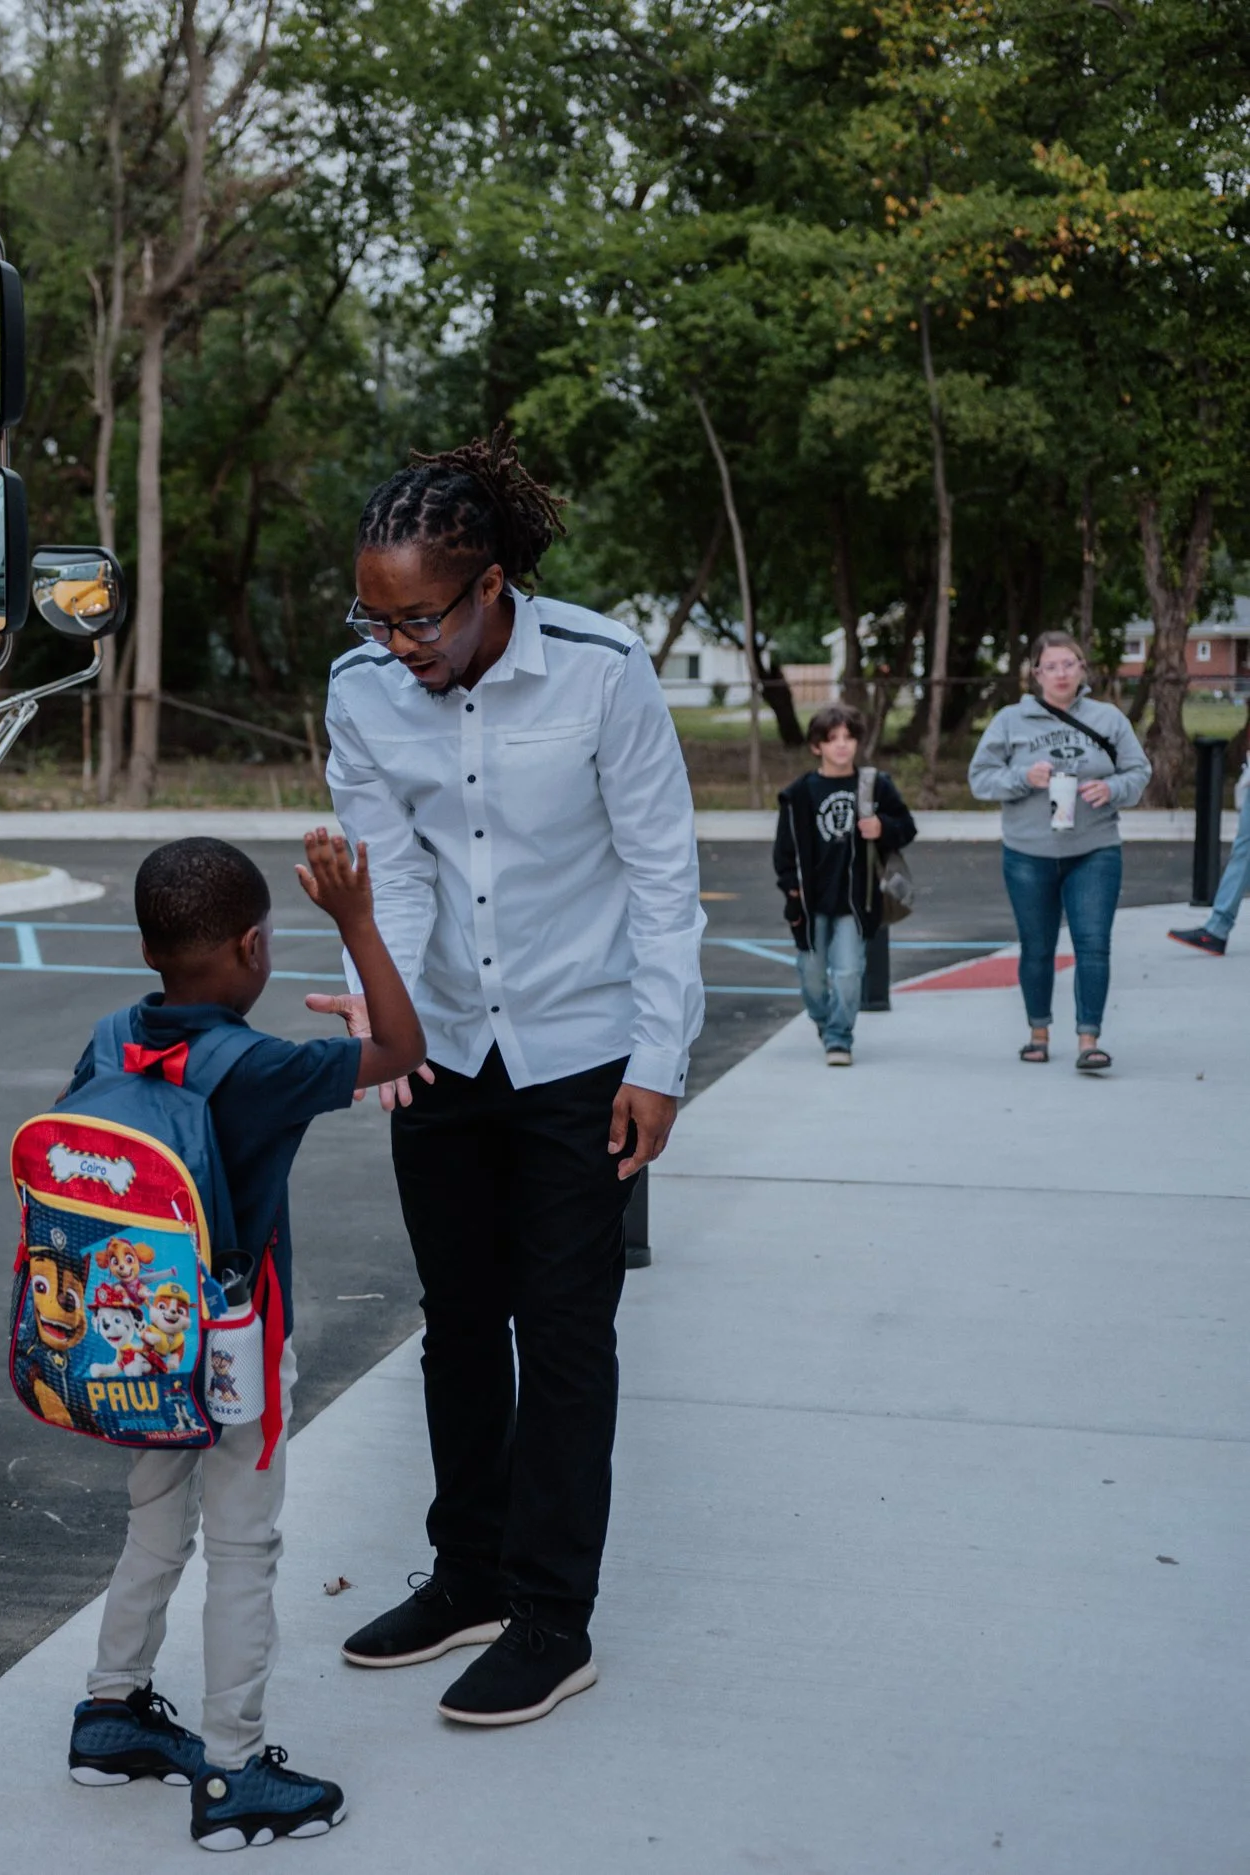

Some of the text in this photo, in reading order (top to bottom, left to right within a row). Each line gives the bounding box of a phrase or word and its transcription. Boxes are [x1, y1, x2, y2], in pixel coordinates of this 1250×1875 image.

[79, 1160, 107, 1176] Cairo
[86, 1381, 160, 1412] PAW
[206, 1400, 242, 1415] Cairo
